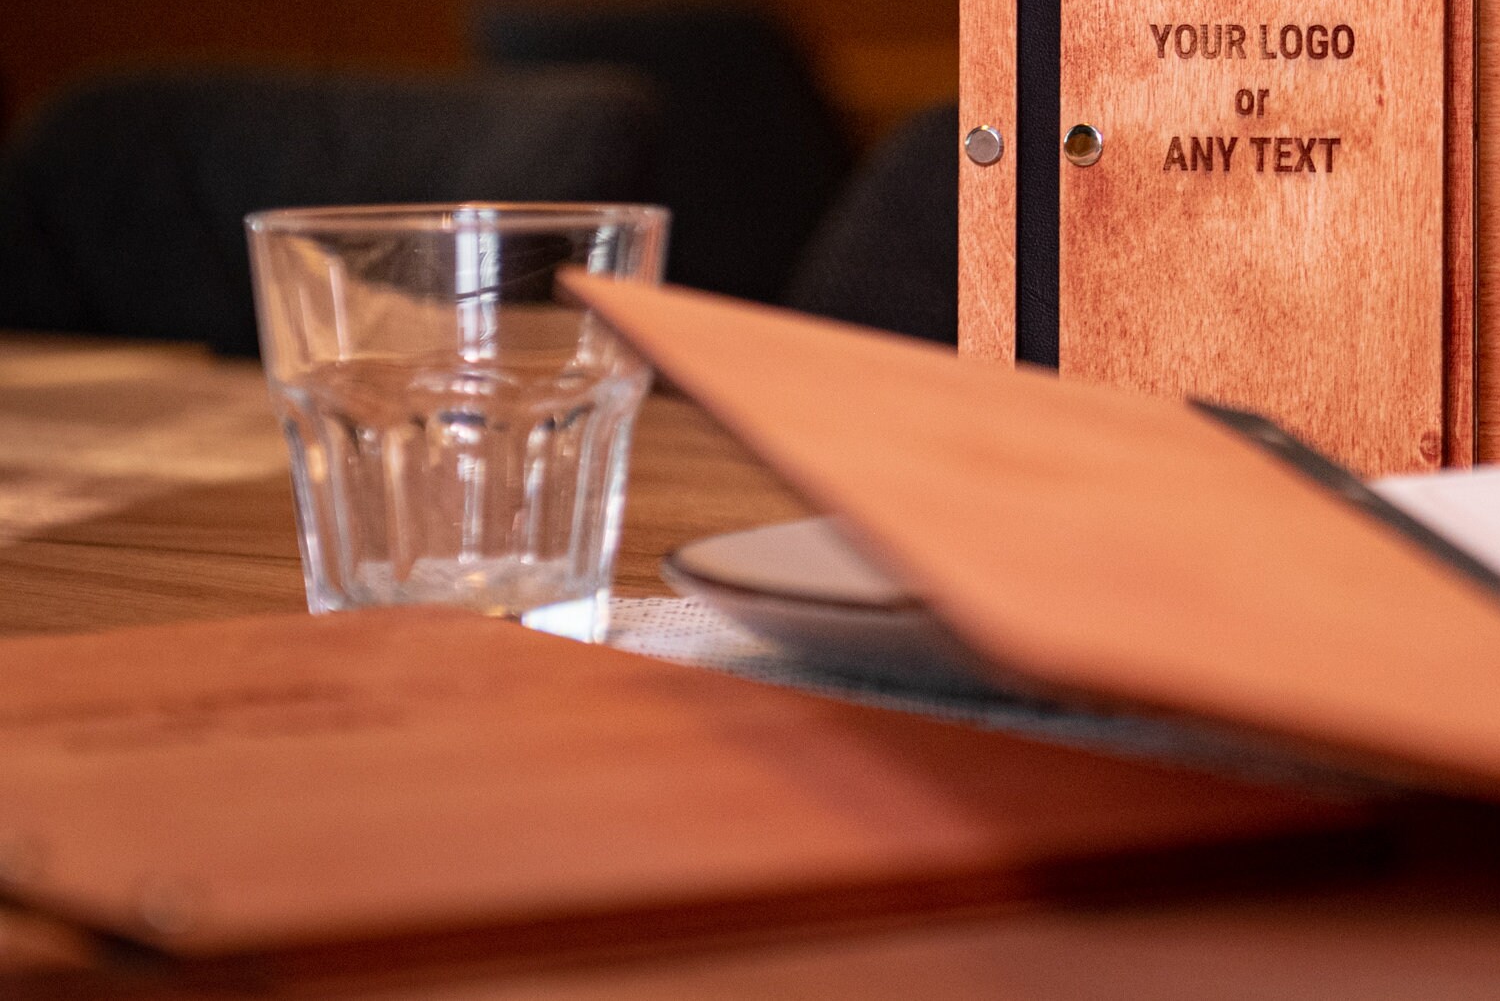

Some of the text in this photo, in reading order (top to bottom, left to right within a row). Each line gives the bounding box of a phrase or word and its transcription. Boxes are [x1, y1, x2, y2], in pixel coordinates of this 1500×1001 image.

[1150, 24, 1355, 60] YOUR LOGO
[1234, 88, 1270, 117] or
[1162, 136, 1341, 173] ANY TEXT
